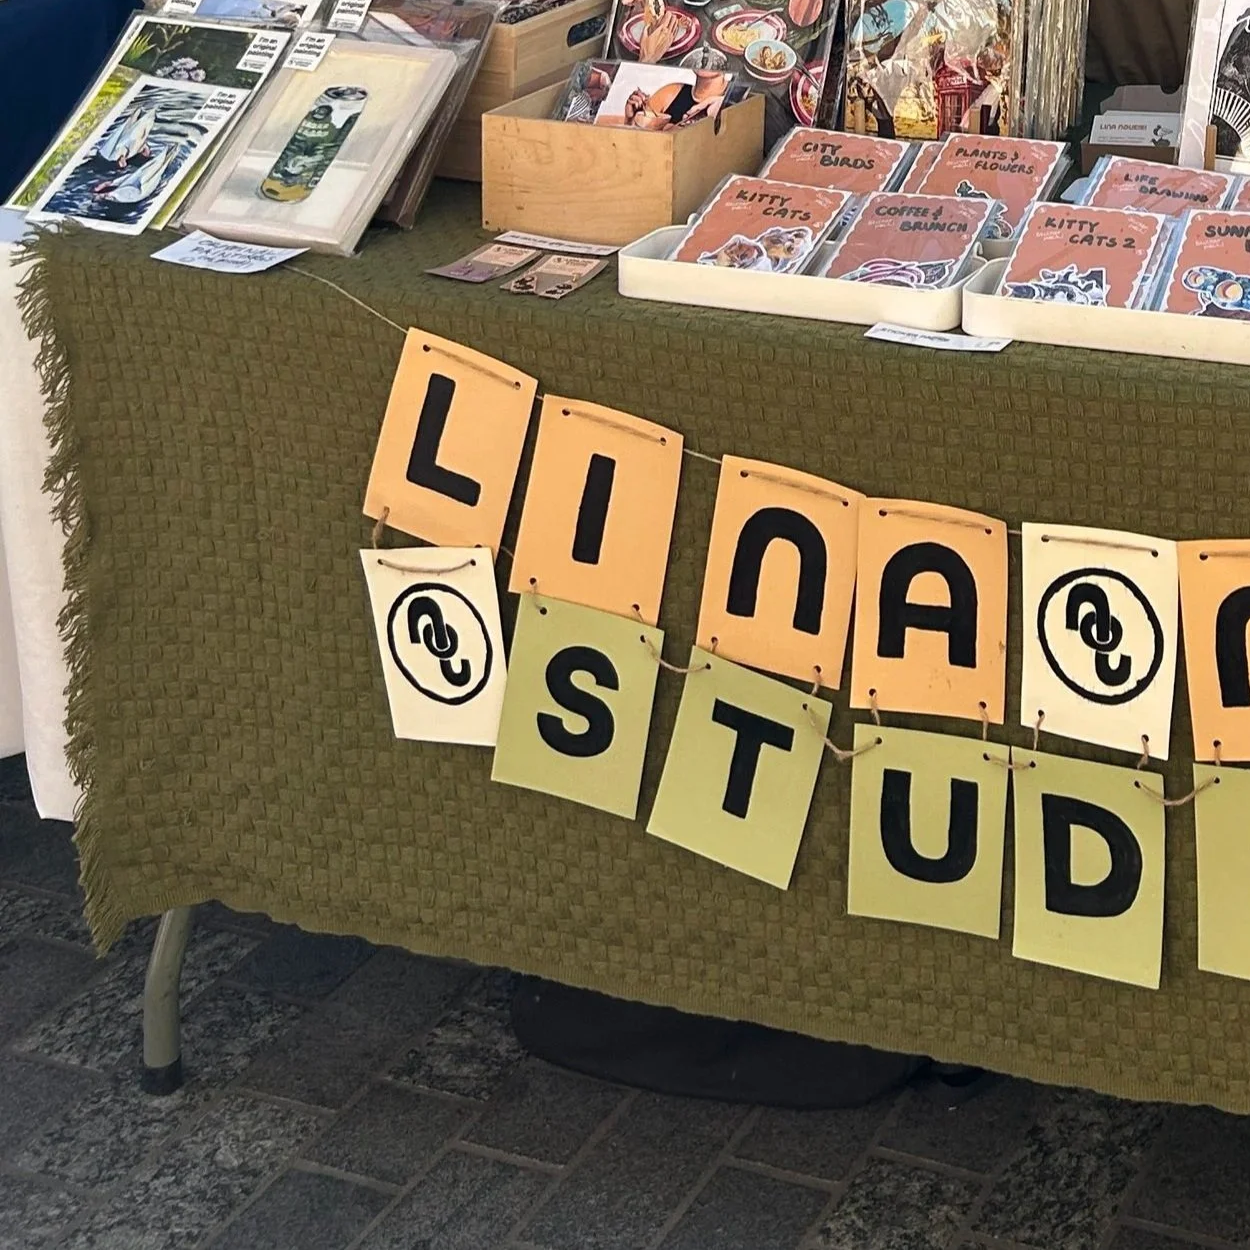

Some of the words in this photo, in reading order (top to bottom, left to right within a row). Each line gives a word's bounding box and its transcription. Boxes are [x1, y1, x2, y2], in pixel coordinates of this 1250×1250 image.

[341, 1, 365, 9] original
[336, 8, 364, 17] painting
[252, 42, 277, 51] original
[299, 42, 324, 50] original
[247, 49, 275, 59] painting
[293, 48, 321, 58] painting
[209, 97, 235, 105] original
[203, 103, 231, 113] painting
[802, 142, 843, 156] CITY
[955, 147, 1008, 161] PLANTS
[819, 154, 875, 170] BIRDS
[974, 160, 1035, 175] FLOWERS
[1124, 173, 1159, 186] LIFE
[735, 189, 792, 207] KITTY
[1138, 185, 1209, 203] DRAWING
[762, 207, 811, 221] CATS
[874, 205, 930, 217] COFFEE
[898, 221, 968, 232] BRUNCH
[1044, 216, 1100, 233] KITTY
[1068, 234, 1118, 248] CATS
[1122, 237, 1136, 249] 2
[406, 373, 978, 668] LINA
